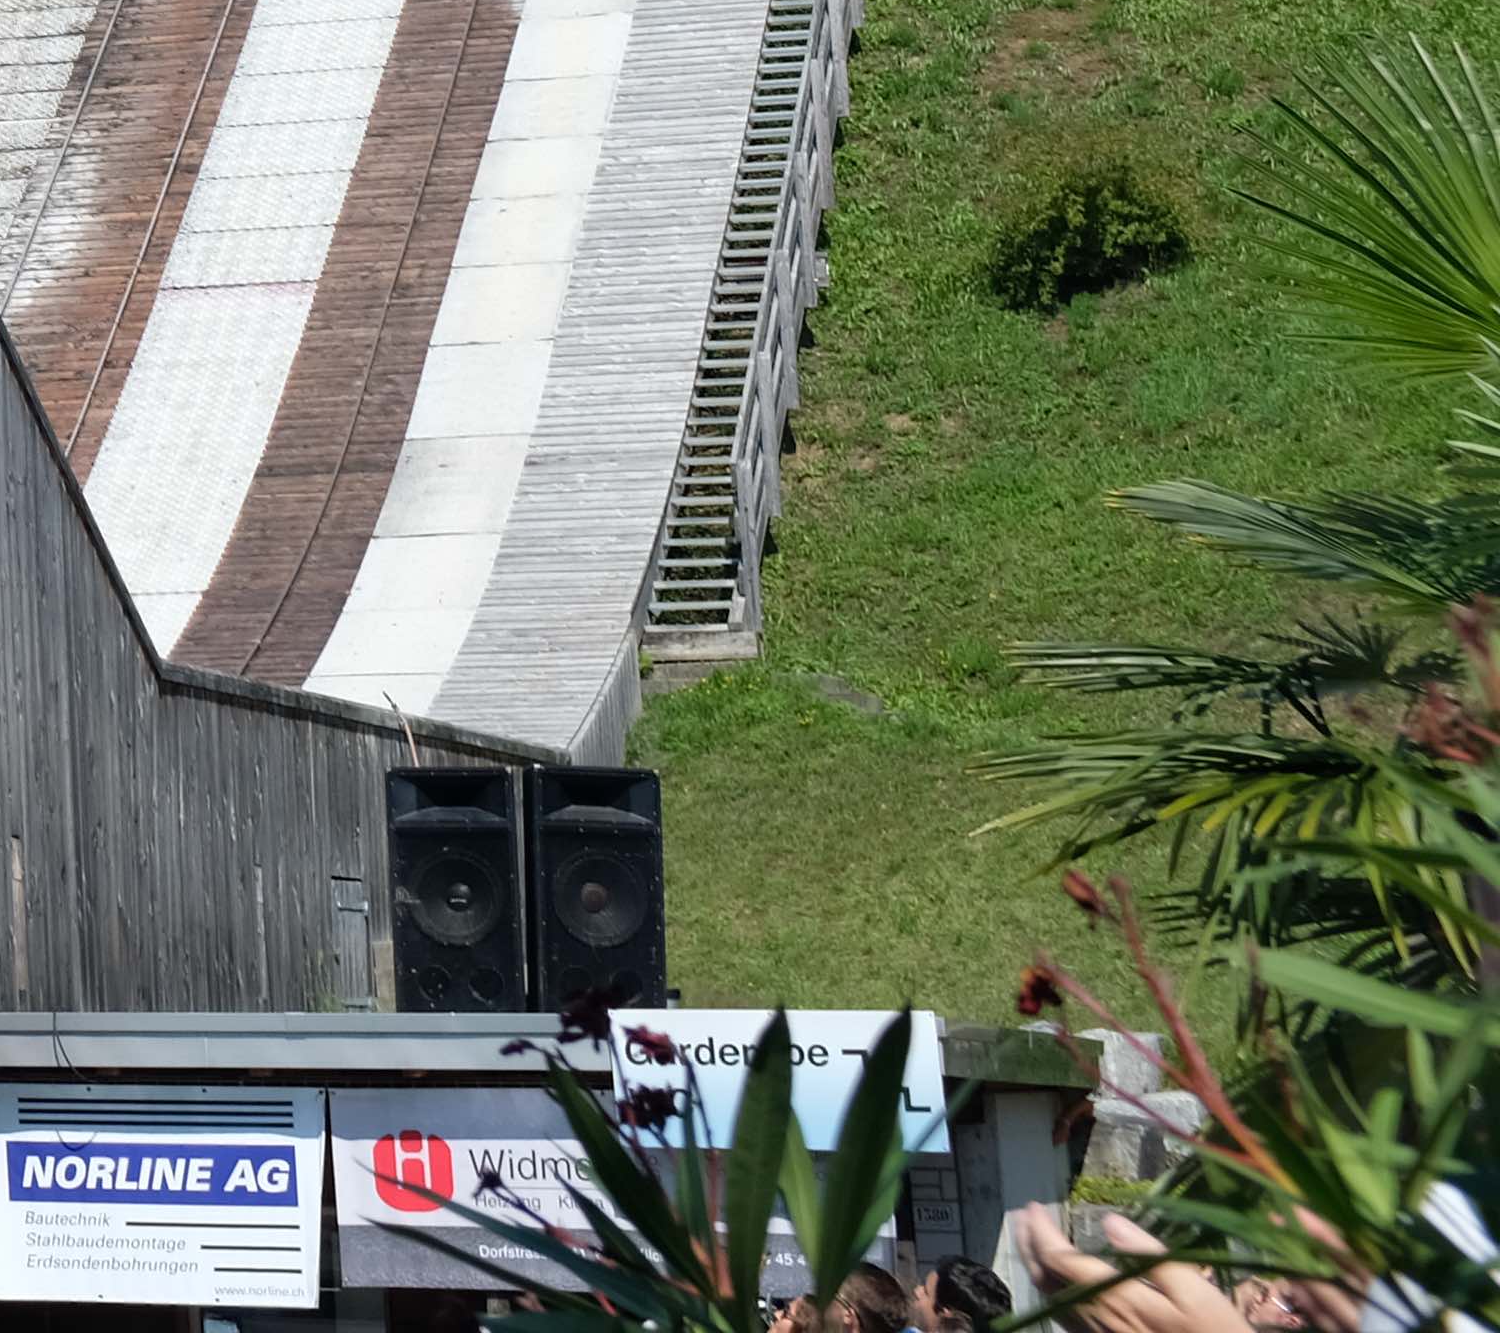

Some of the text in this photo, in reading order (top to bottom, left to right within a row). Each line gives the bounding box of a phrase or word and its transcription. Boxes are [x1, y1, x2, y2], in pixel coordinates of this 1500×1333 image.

[21, 1155, 291, 1194] NORLINE AG
[24, 1210, 112, 1228] Bautechnik
[25, 1232, 187, 1253] Stahlbaudemontage
[26, 1254, 200, 1276] Erdsondenbohrungen
[214, 1284, 306, 1299] www.norline.ch
